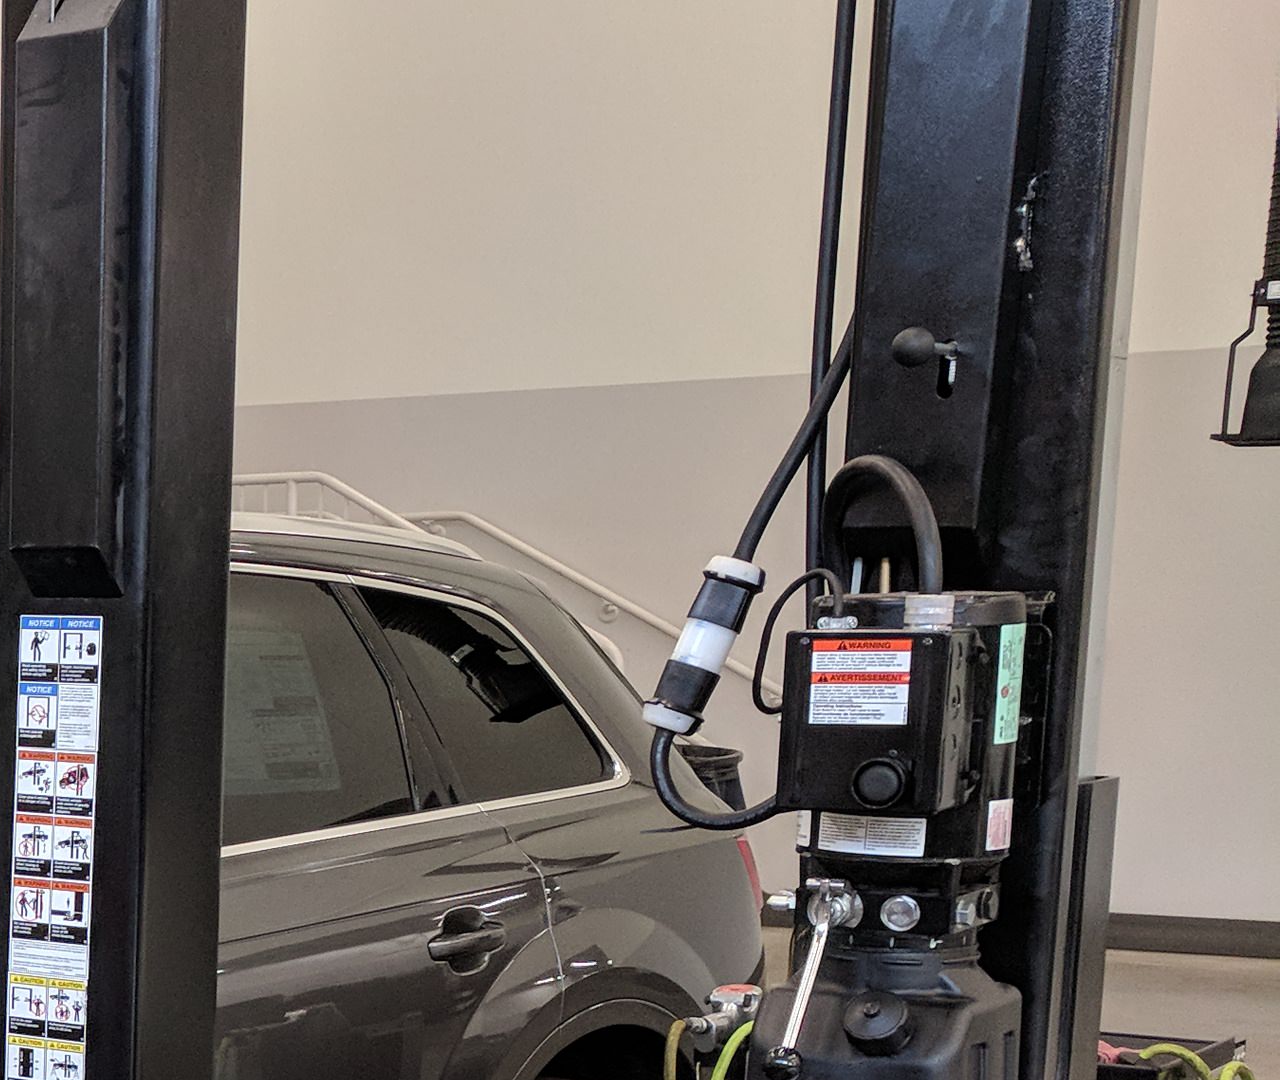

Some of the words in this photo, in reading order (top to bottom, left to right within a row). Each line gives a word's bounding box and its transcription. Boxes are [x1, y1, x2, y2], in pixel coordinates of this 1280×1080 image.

[28, 619, 55, 627] NOTICE
[67, 620, 95, 628] NOTICE
[830, 674, 903, 682] AVERTISSEMENT
[20, 977, 44, 985] CAUTION
[58, 981, 83, 989] CAUTION
[18, 1038, 43, 1046] CAUTION
[56, 1043, 81, 1051] CAUTION
